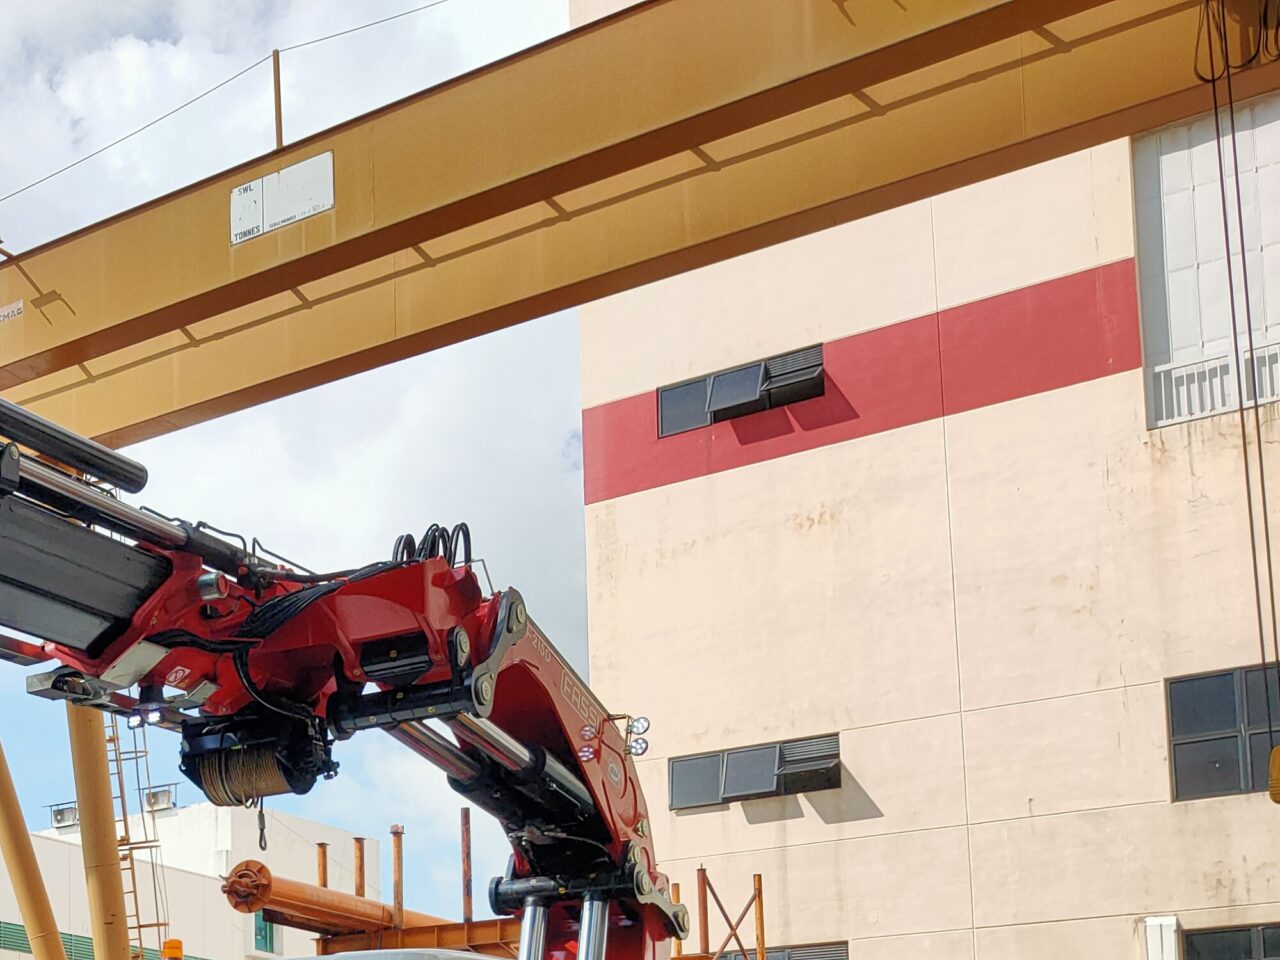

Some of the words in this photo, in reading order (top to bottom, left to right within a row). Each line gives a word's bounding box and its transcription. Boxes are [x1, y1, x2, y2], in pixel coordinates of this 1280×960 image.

[237, 184, 254, 196] SWL
[234, 225, 261, 242] TONNES
[562, 676, 601, 728] FASSI
